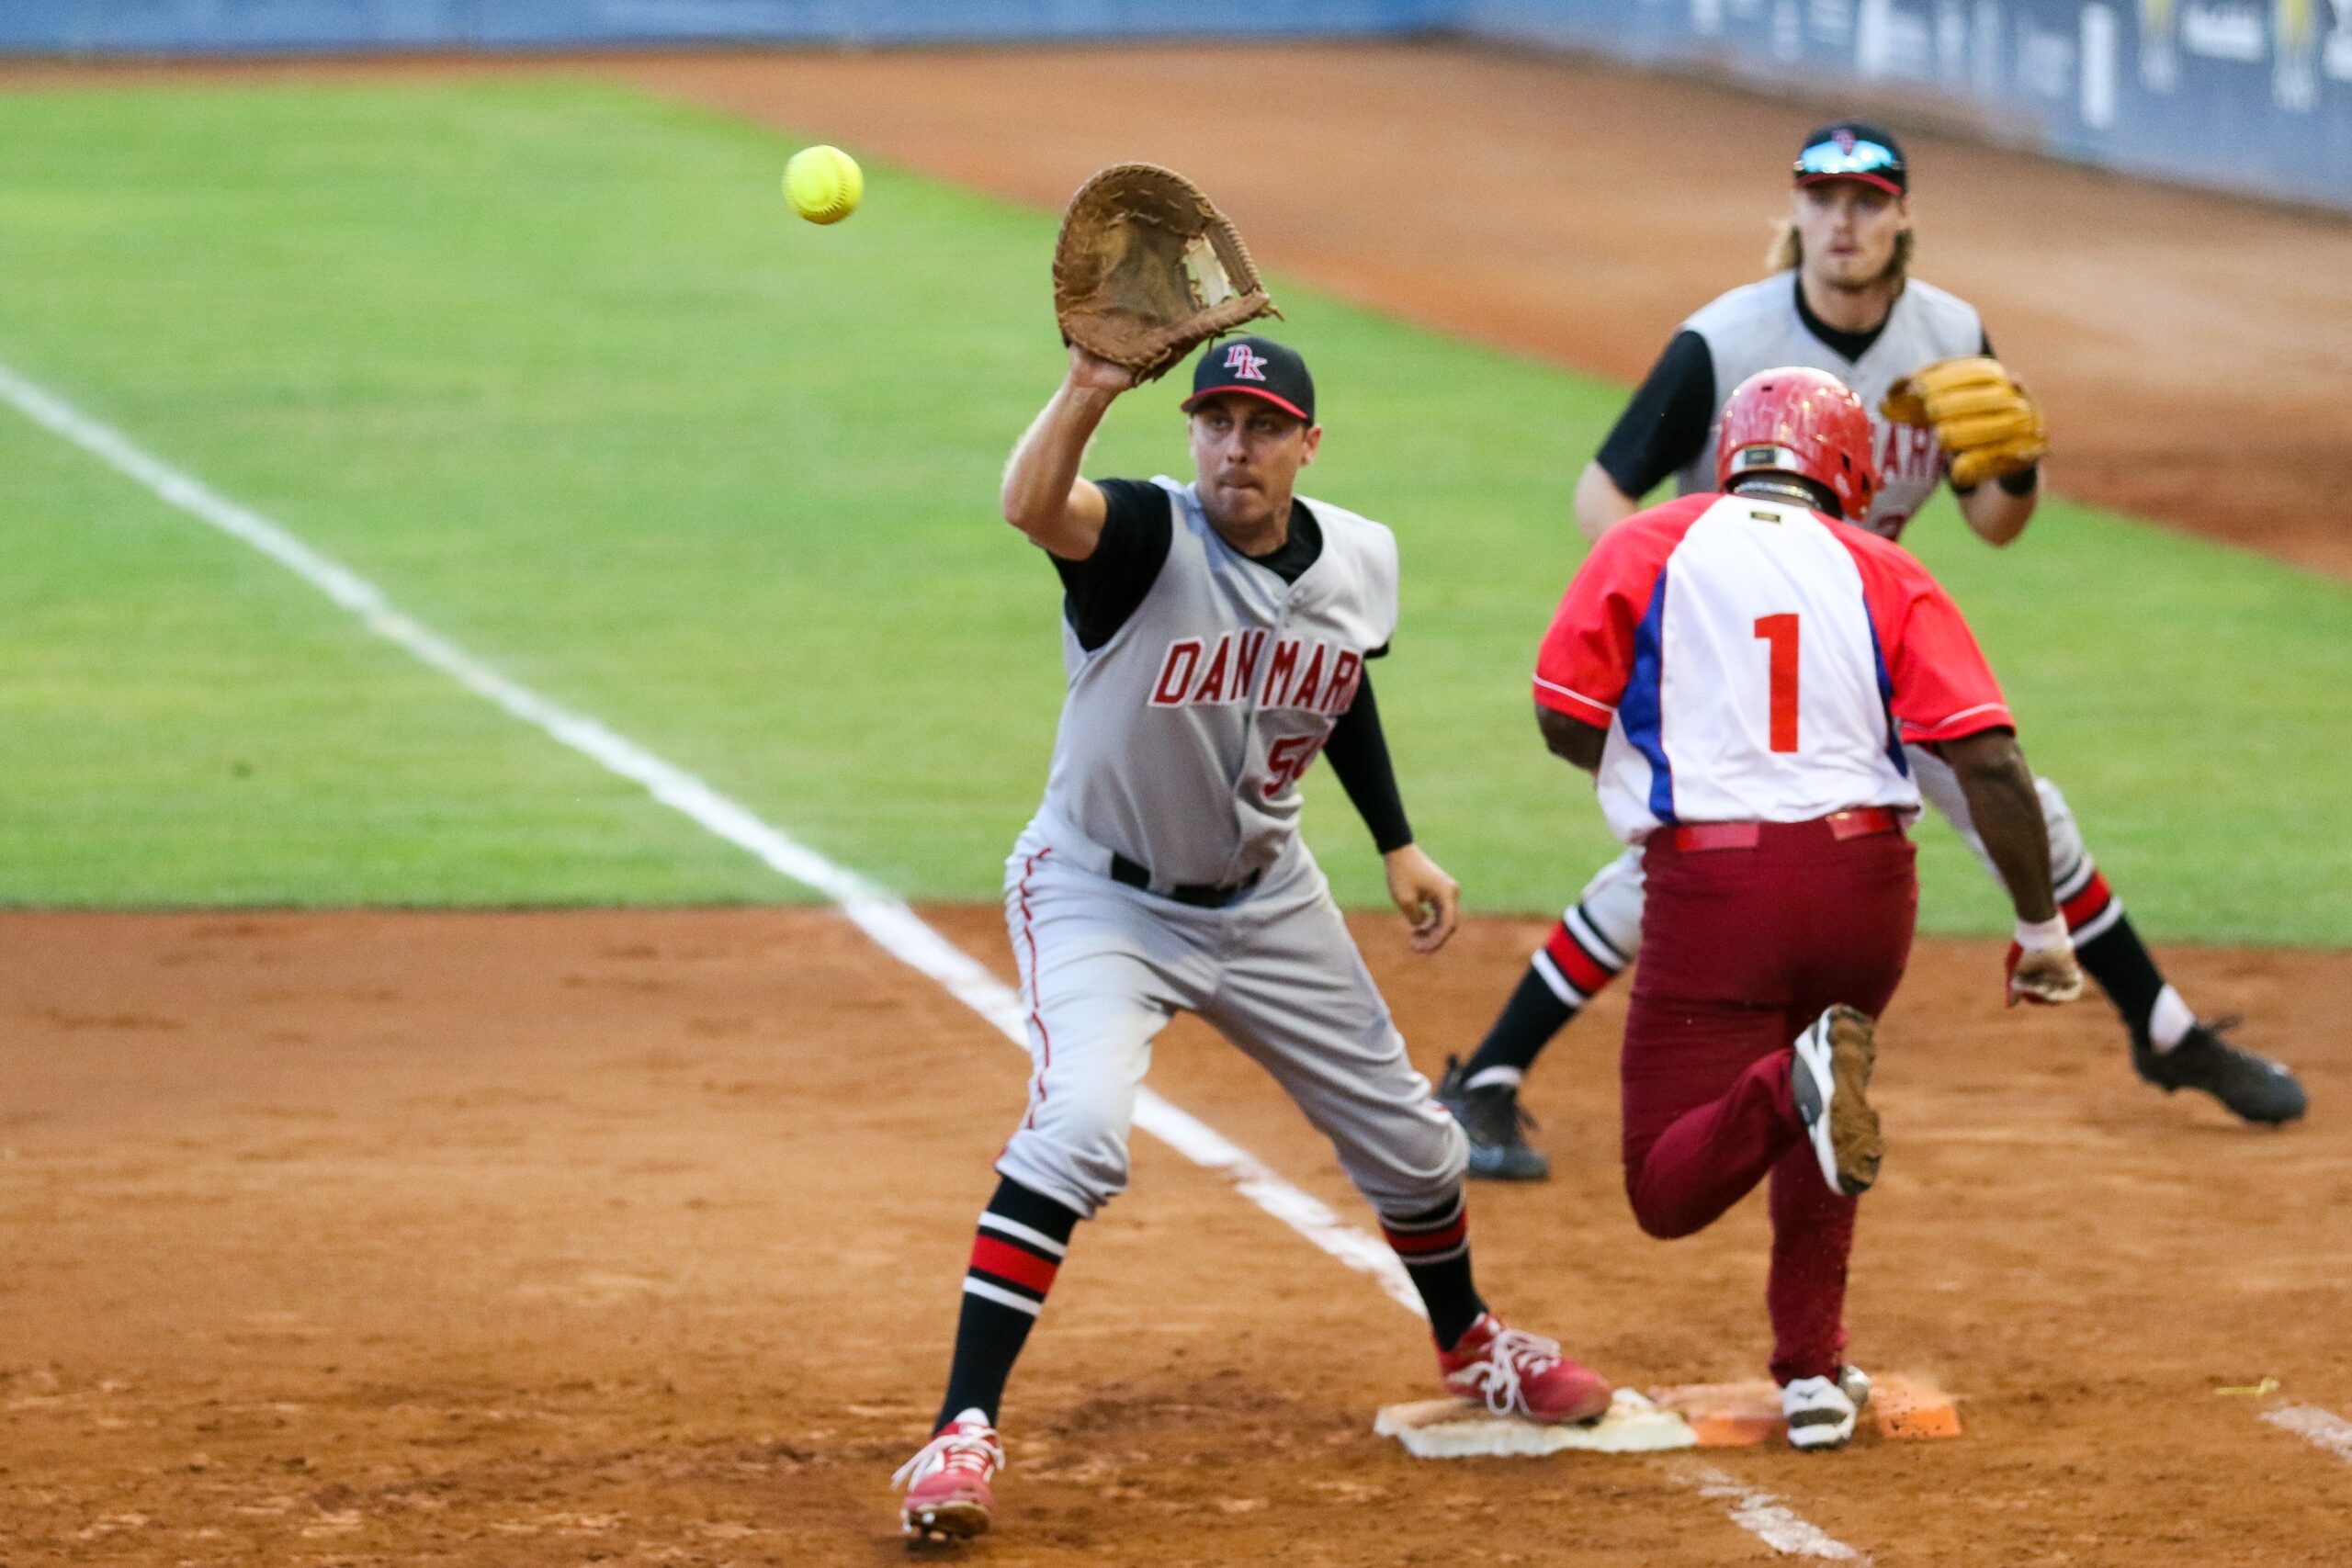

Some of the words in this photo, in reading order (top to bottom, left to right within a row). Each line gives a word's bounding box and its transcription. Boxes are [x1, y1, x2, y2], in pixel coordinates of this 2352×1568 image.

[1224, 344, 1268, 381] DK
[1148, 626, 1363, 716] DANMAR
[1754, 613, 1799, 752] 1
